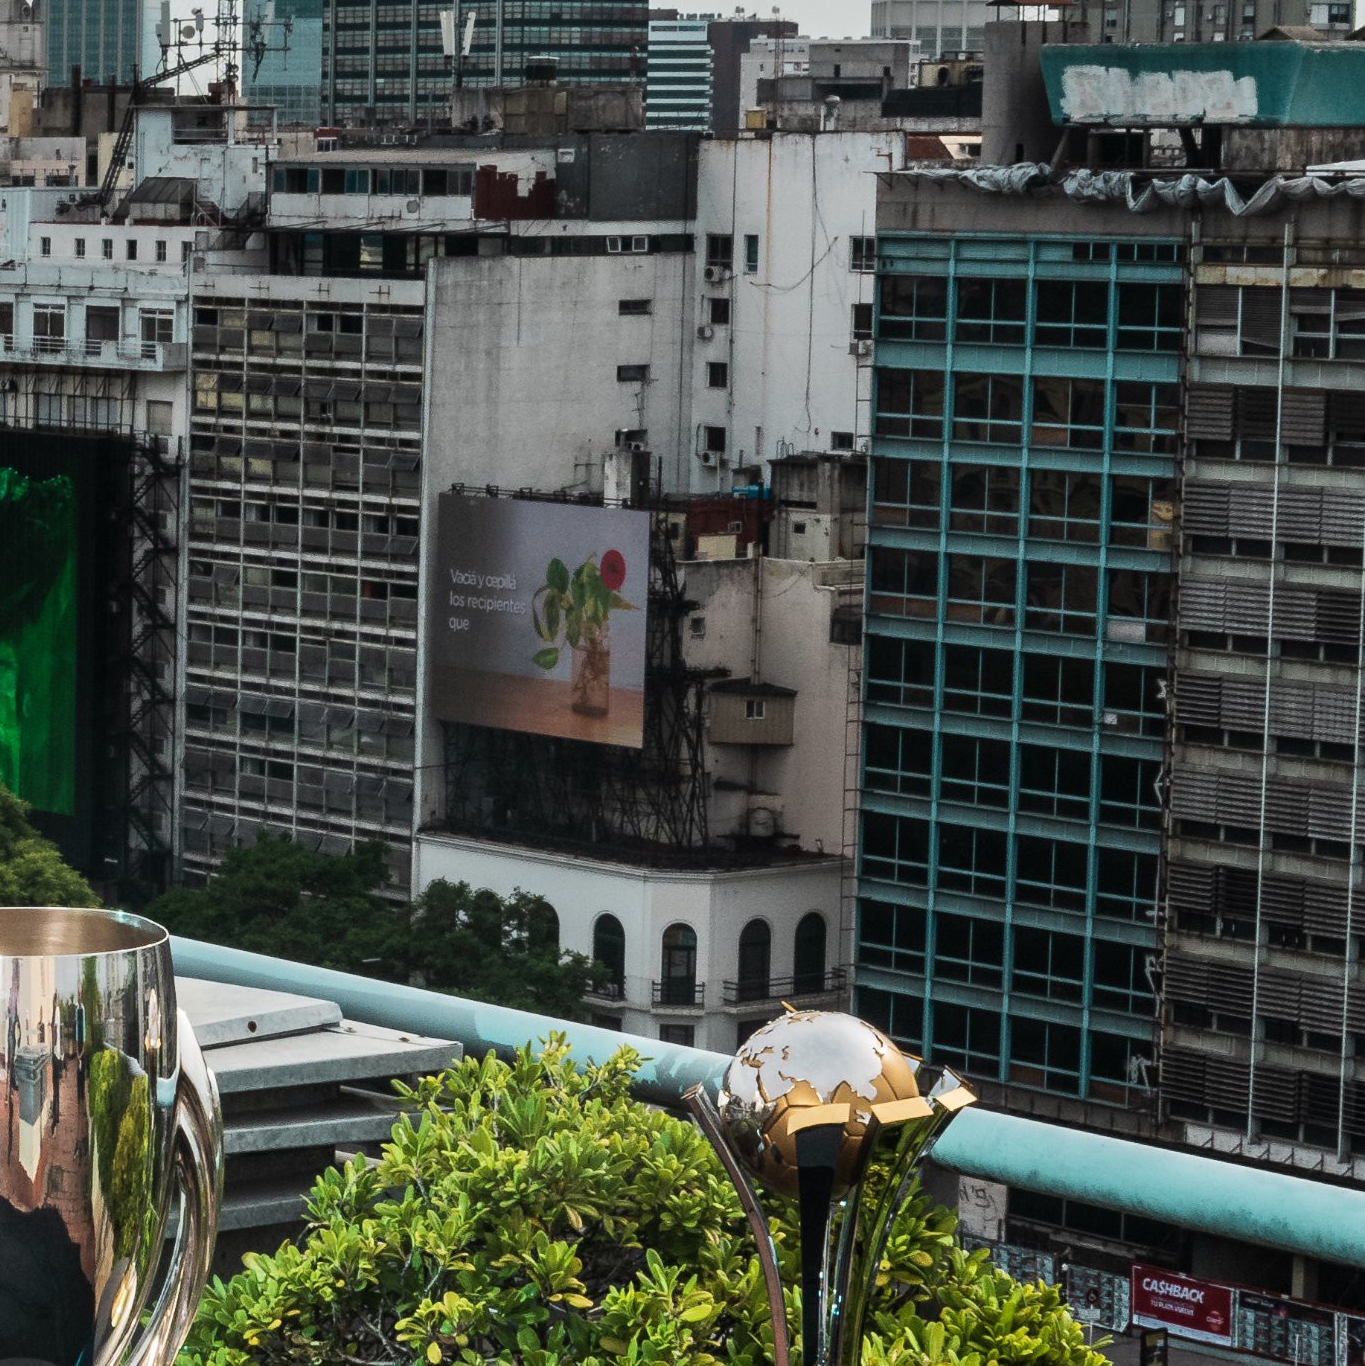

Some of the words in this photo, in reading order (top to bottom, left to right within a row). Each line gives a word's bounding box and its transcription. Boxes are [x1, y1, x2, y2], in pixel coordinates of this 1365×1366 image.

[477, 575, 484, 589] y
[450, 590, 465, 607] los
[467, 596, 526, 615] recipientes
[449, 617, 469, 632] que
